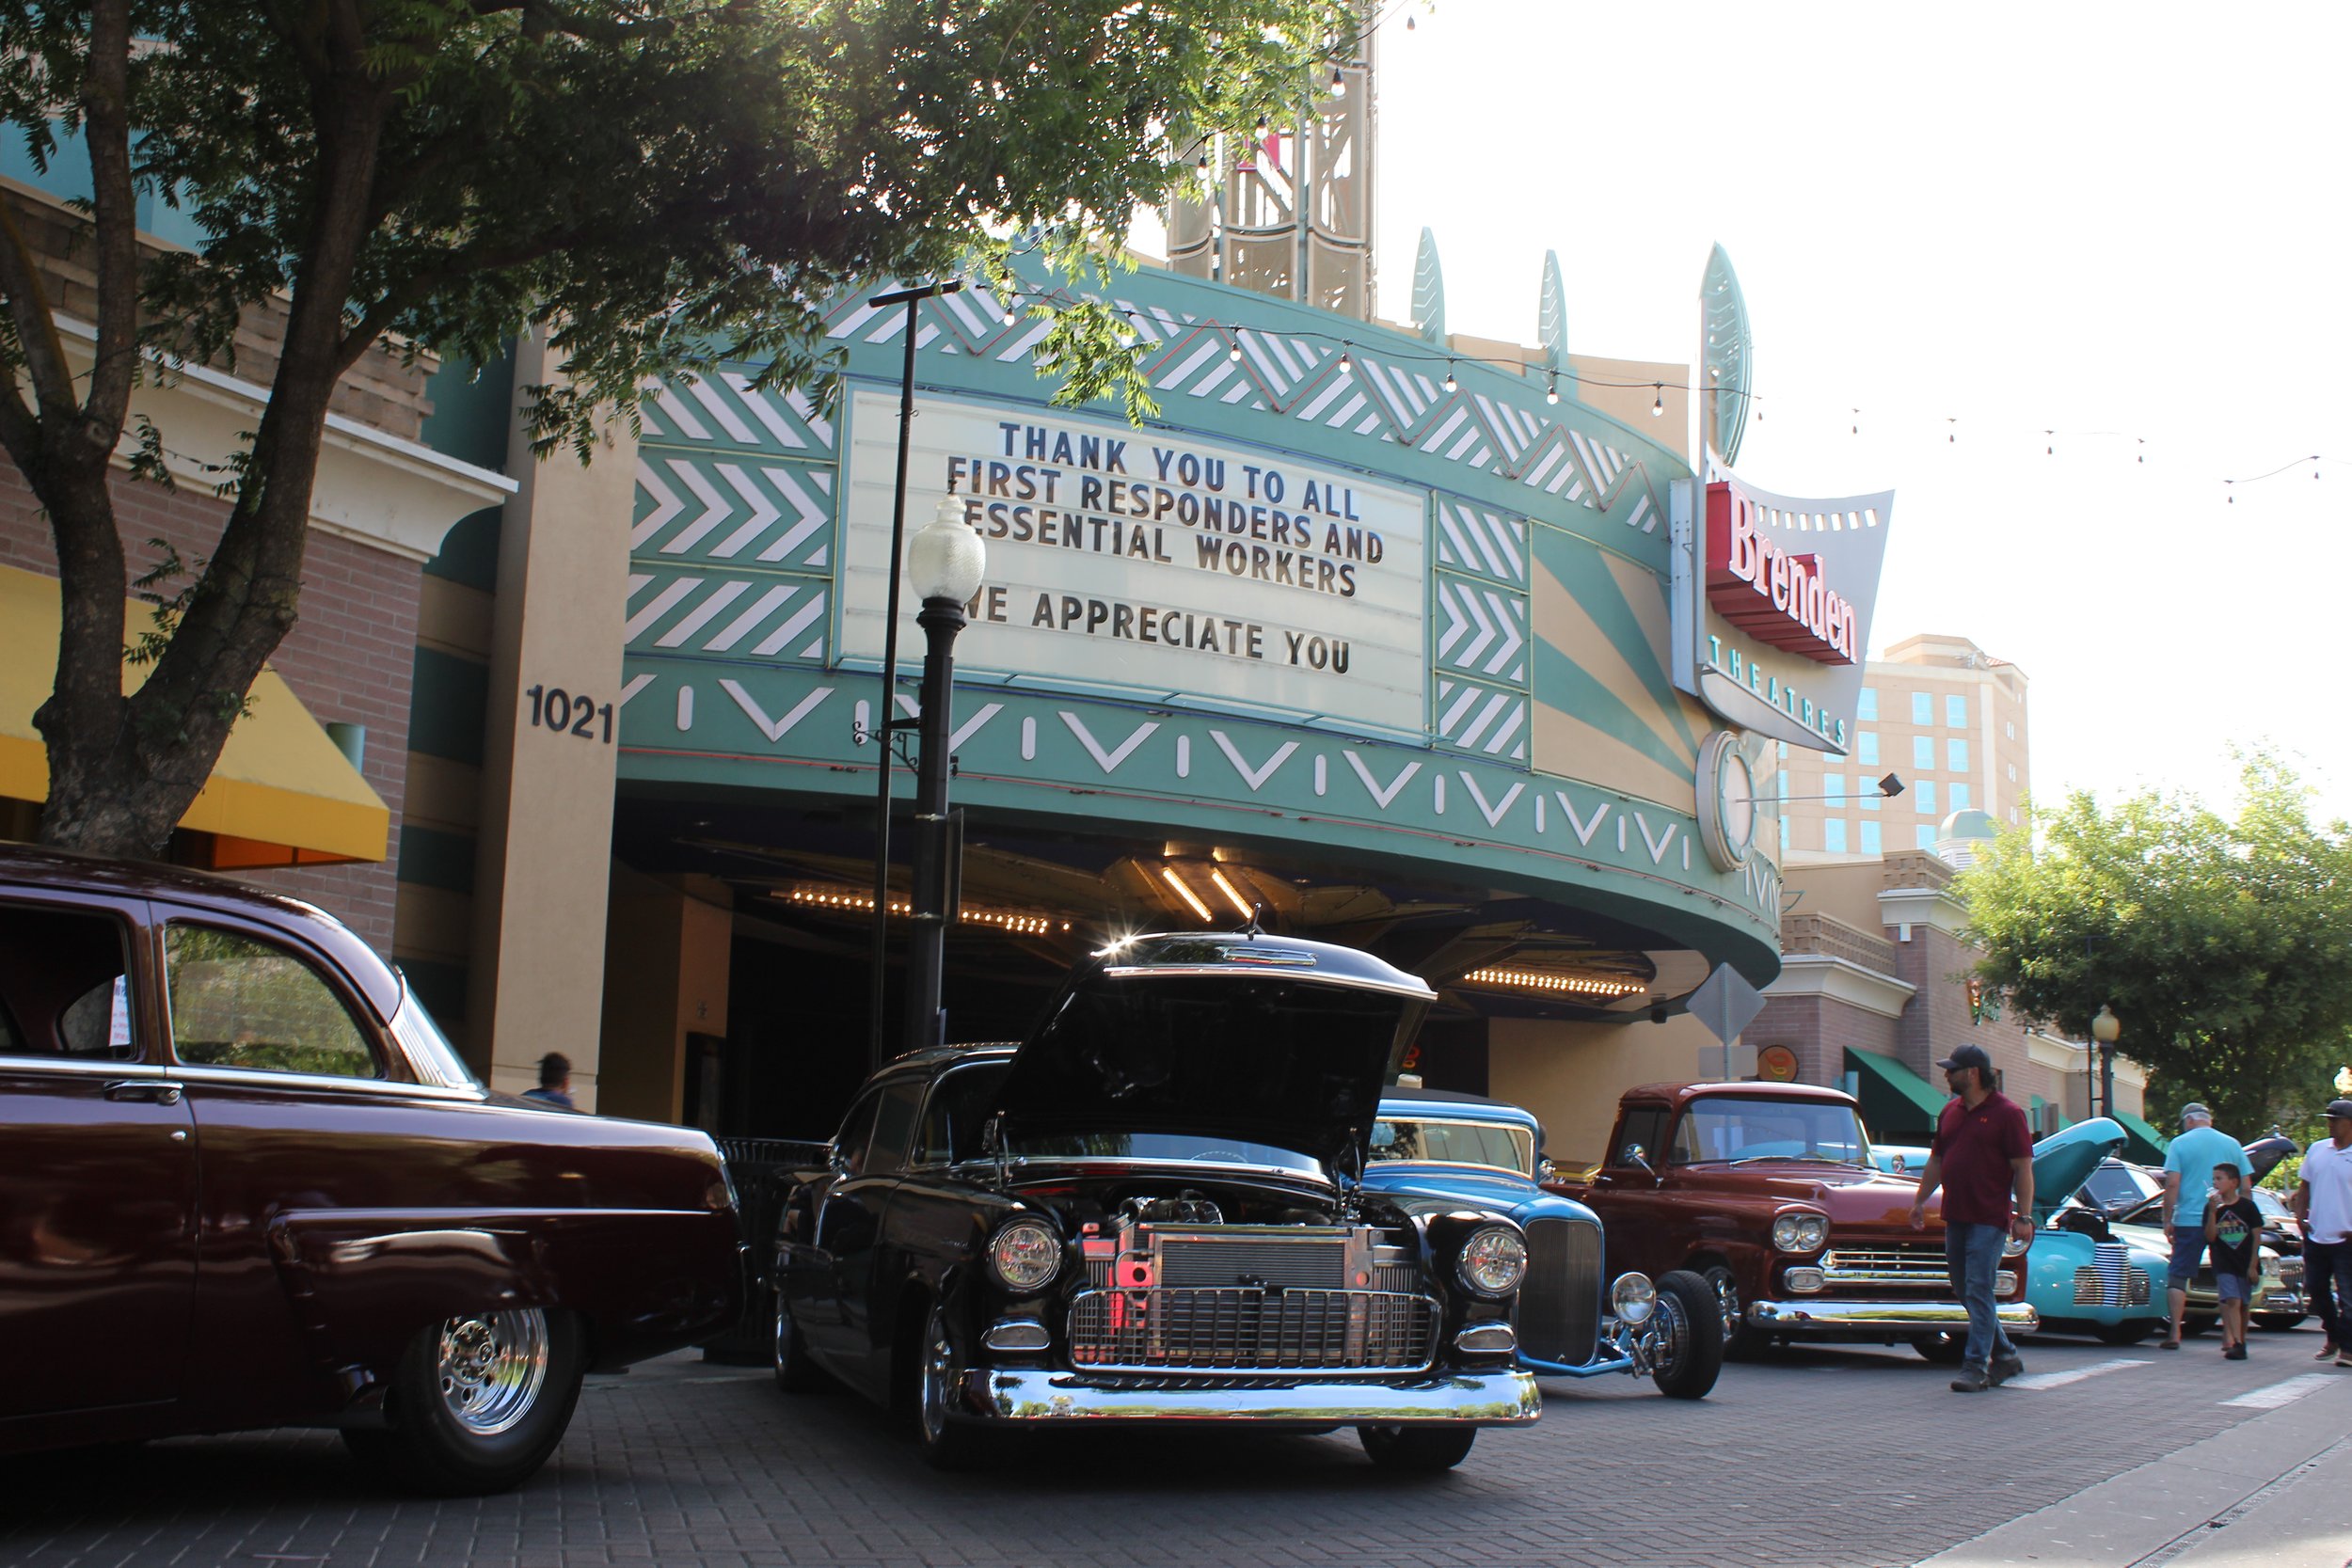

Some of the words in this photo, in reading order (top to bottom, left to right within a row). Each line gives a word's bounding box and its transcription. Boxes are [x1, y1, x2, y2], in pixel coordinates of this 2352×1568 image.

[947, 455, 1062, 504] FIRST
[1081, 474, 1311, 549] RESPONDERS
[1324, 523, 1384, 564] AND
[999, 421, 1128, 475] THANK
[1152, 446, 1225, 493] YOU
[1243, 465, 1284, 504] TO
[1302, 480, 1359, 522] ALL
[964, 499, 1171, 562] ESSENTIAL
[1196, 534, 1357, 597] WORKERS
[1729, 484, 1857, 664] Brenden
[1031, 593, 1263, 659] APPRECIATE
[1285, 630, 1349, 674] YOU
[526, 684, 613, 744] 1021
[1708, 635, 1845, 746] THEATRES
